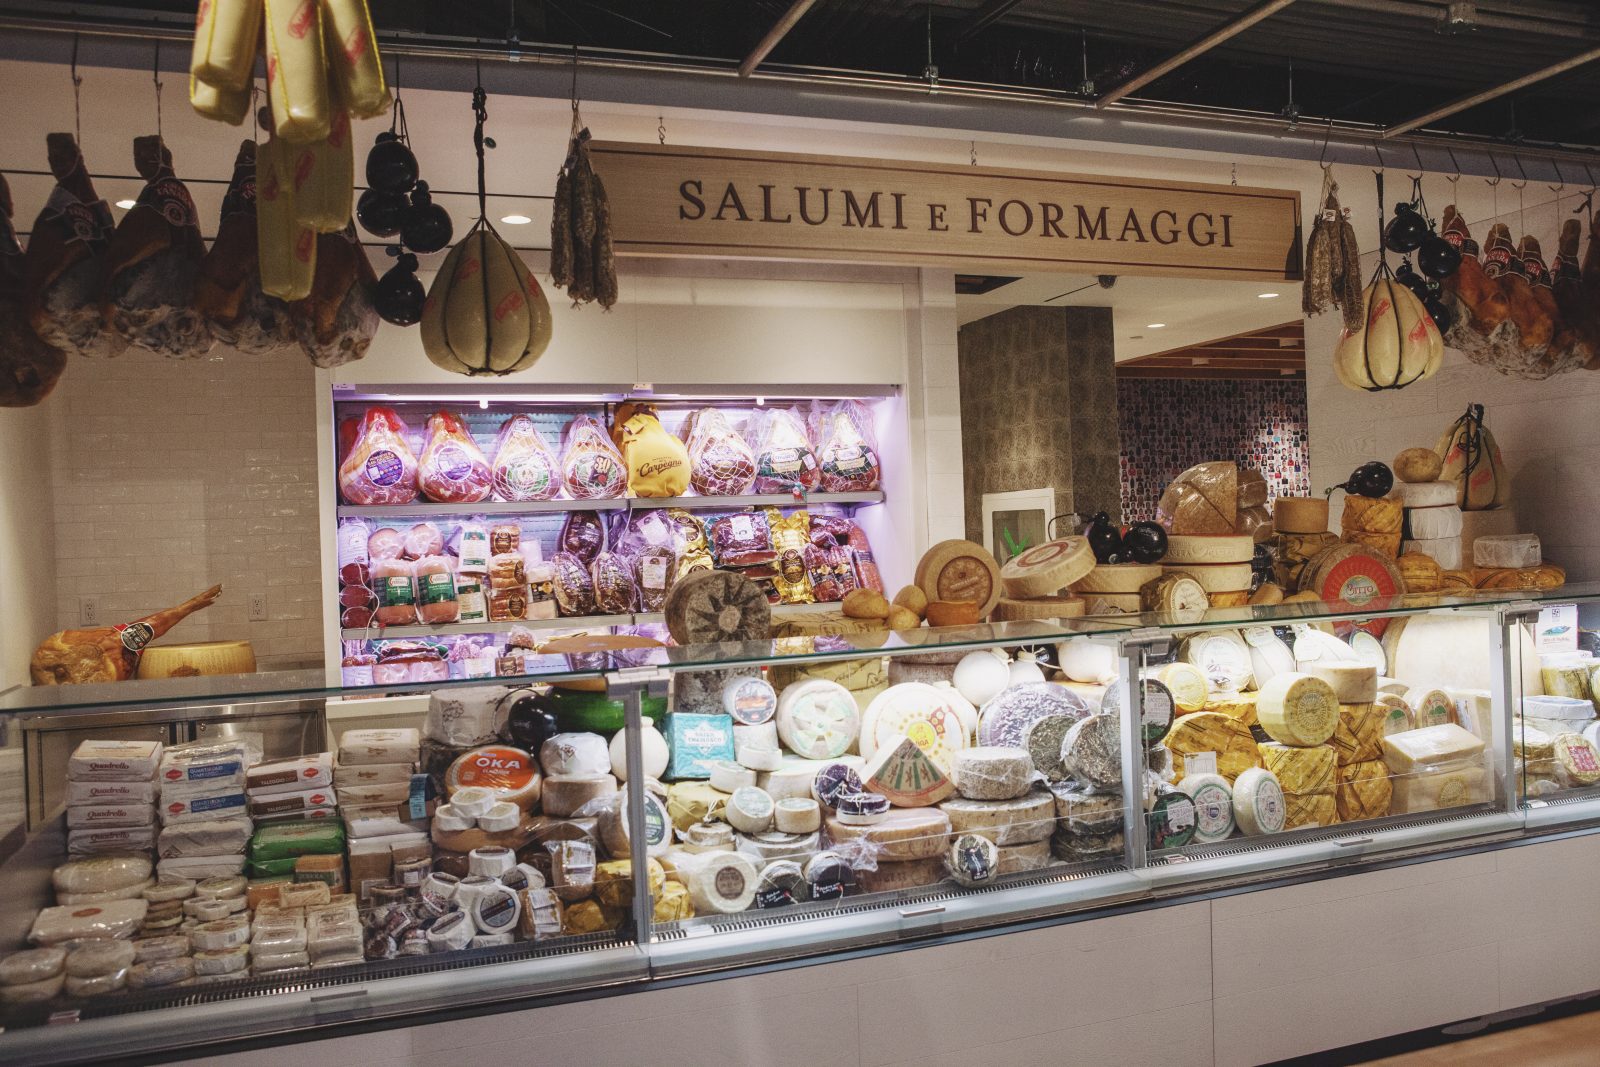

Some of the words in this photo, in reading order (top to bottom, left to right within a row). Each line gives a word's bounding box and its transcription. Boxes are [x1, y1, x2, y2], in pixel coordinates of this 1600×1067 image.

[679, 180, 907, 229] SALUMI
[927, 204, 949, 232] E
[966, 198, 1234, 247] FORMAGGI
[640, 460, 682, 477] Carpegna
[88, 762, 129, 771] Quadrello
[476, 757, 520, 769] OKA
[88, 787, 130, 797] Quadrello
[86, 809, 127, 820] Quadrello
[88, 831, 130, 843] Quadrello
